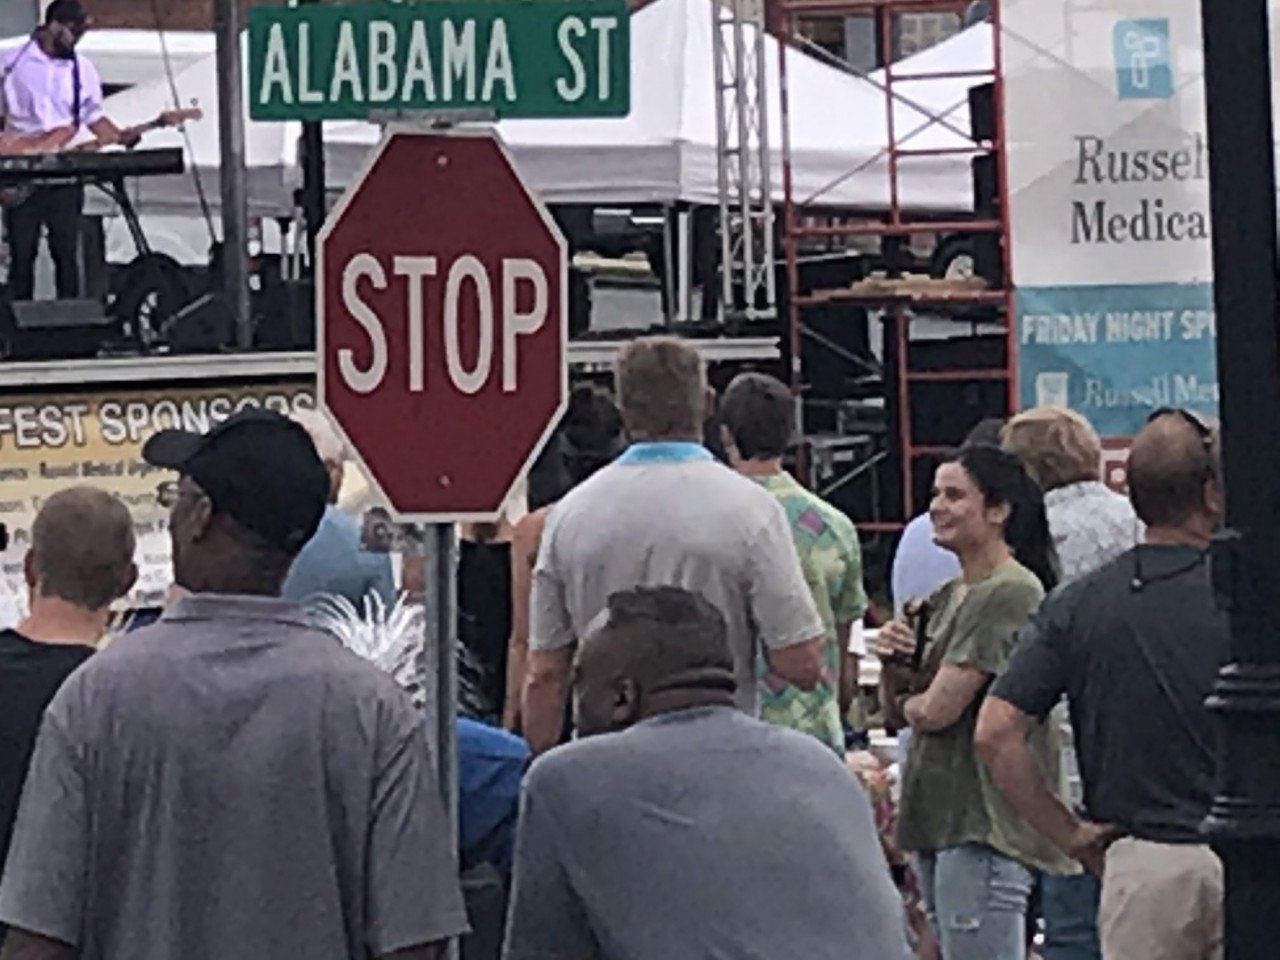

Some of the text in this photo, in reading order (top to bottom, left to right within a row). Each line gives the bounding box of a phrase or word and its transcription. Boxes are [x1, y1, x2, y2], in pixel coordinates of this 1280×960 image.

[259, 15, 619, 105] ALABAMA ST
[1073, 130, 1208, 185] Russel
[1071, 197, 1209, 245] Medica
[337, 253, 550, 395] STOP
[1022, 312, 1101, 345] FRIDAY
[1106, 310, 1174, 342] NIGHT
